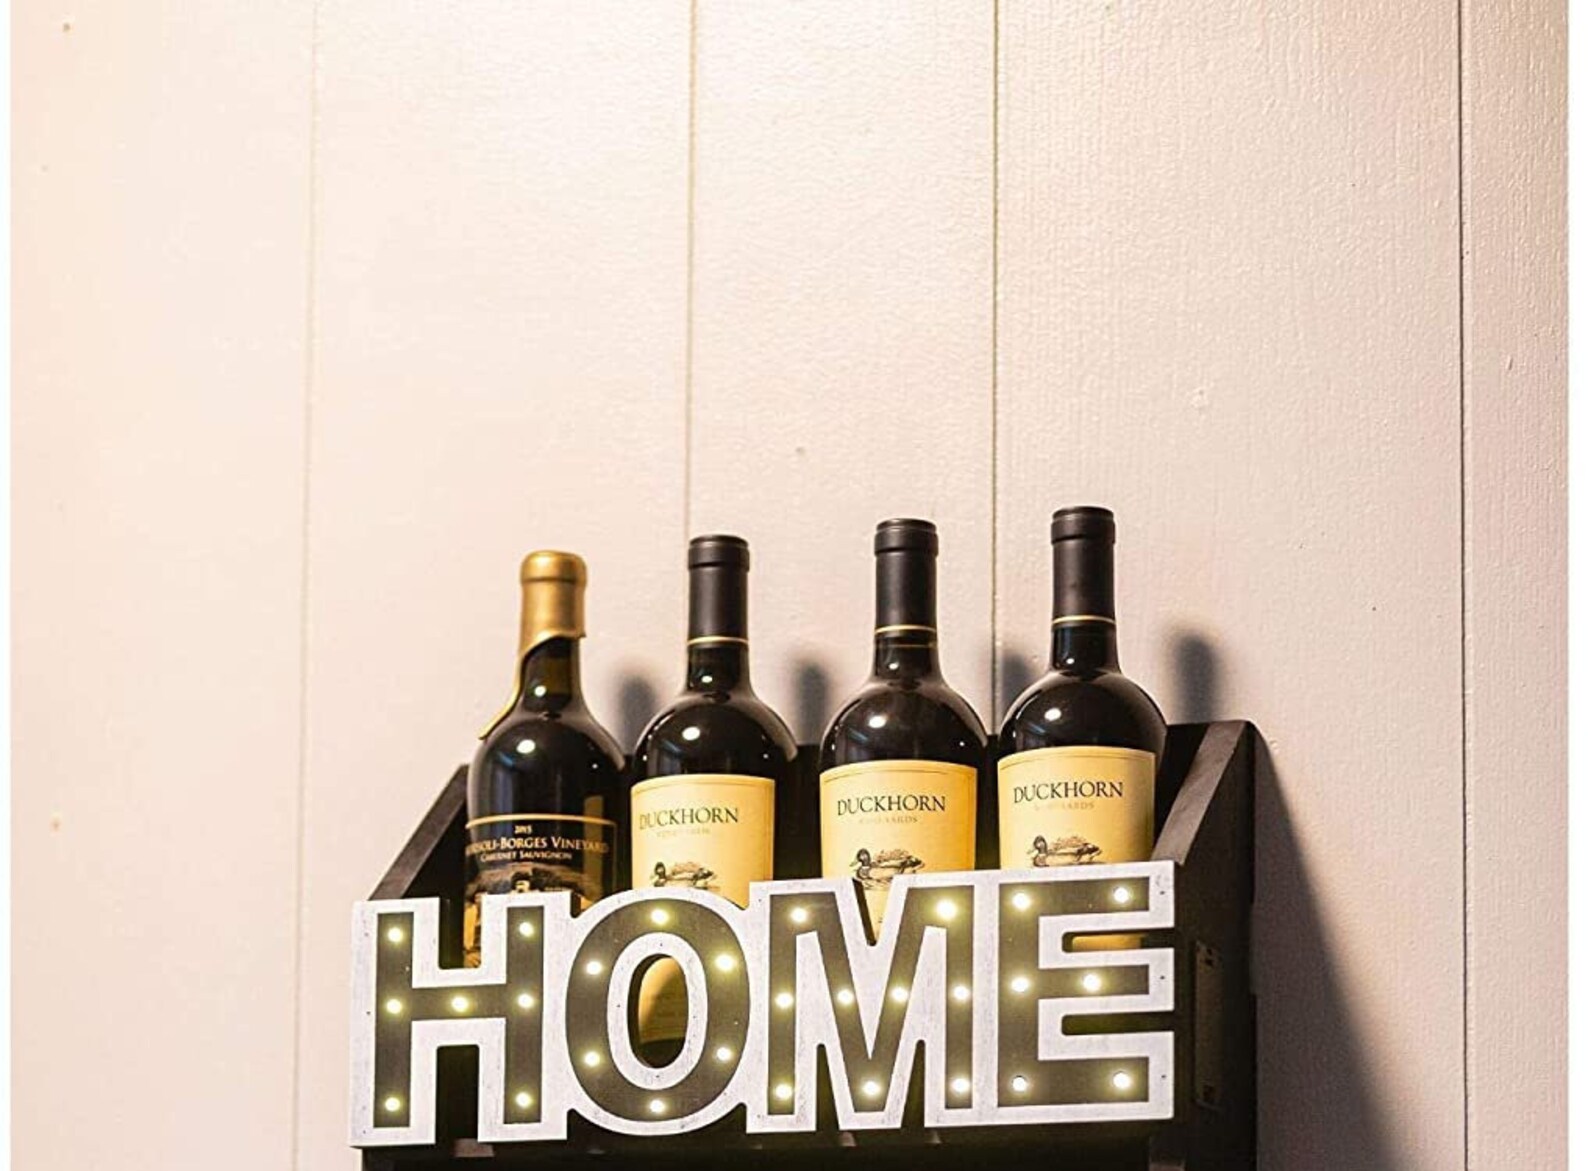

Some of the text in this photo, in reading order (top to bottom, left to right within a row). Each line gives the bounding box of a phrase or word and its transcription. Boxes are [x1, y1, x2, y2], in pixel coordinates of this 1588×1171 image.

[1013, 780, 1124, 804] DUCKHORN
[837, 794, 946, 816] DUCKHORN
[638, 806, 739, 830] DUCKHORN
[351, 860, 1176, 1149] HOME
